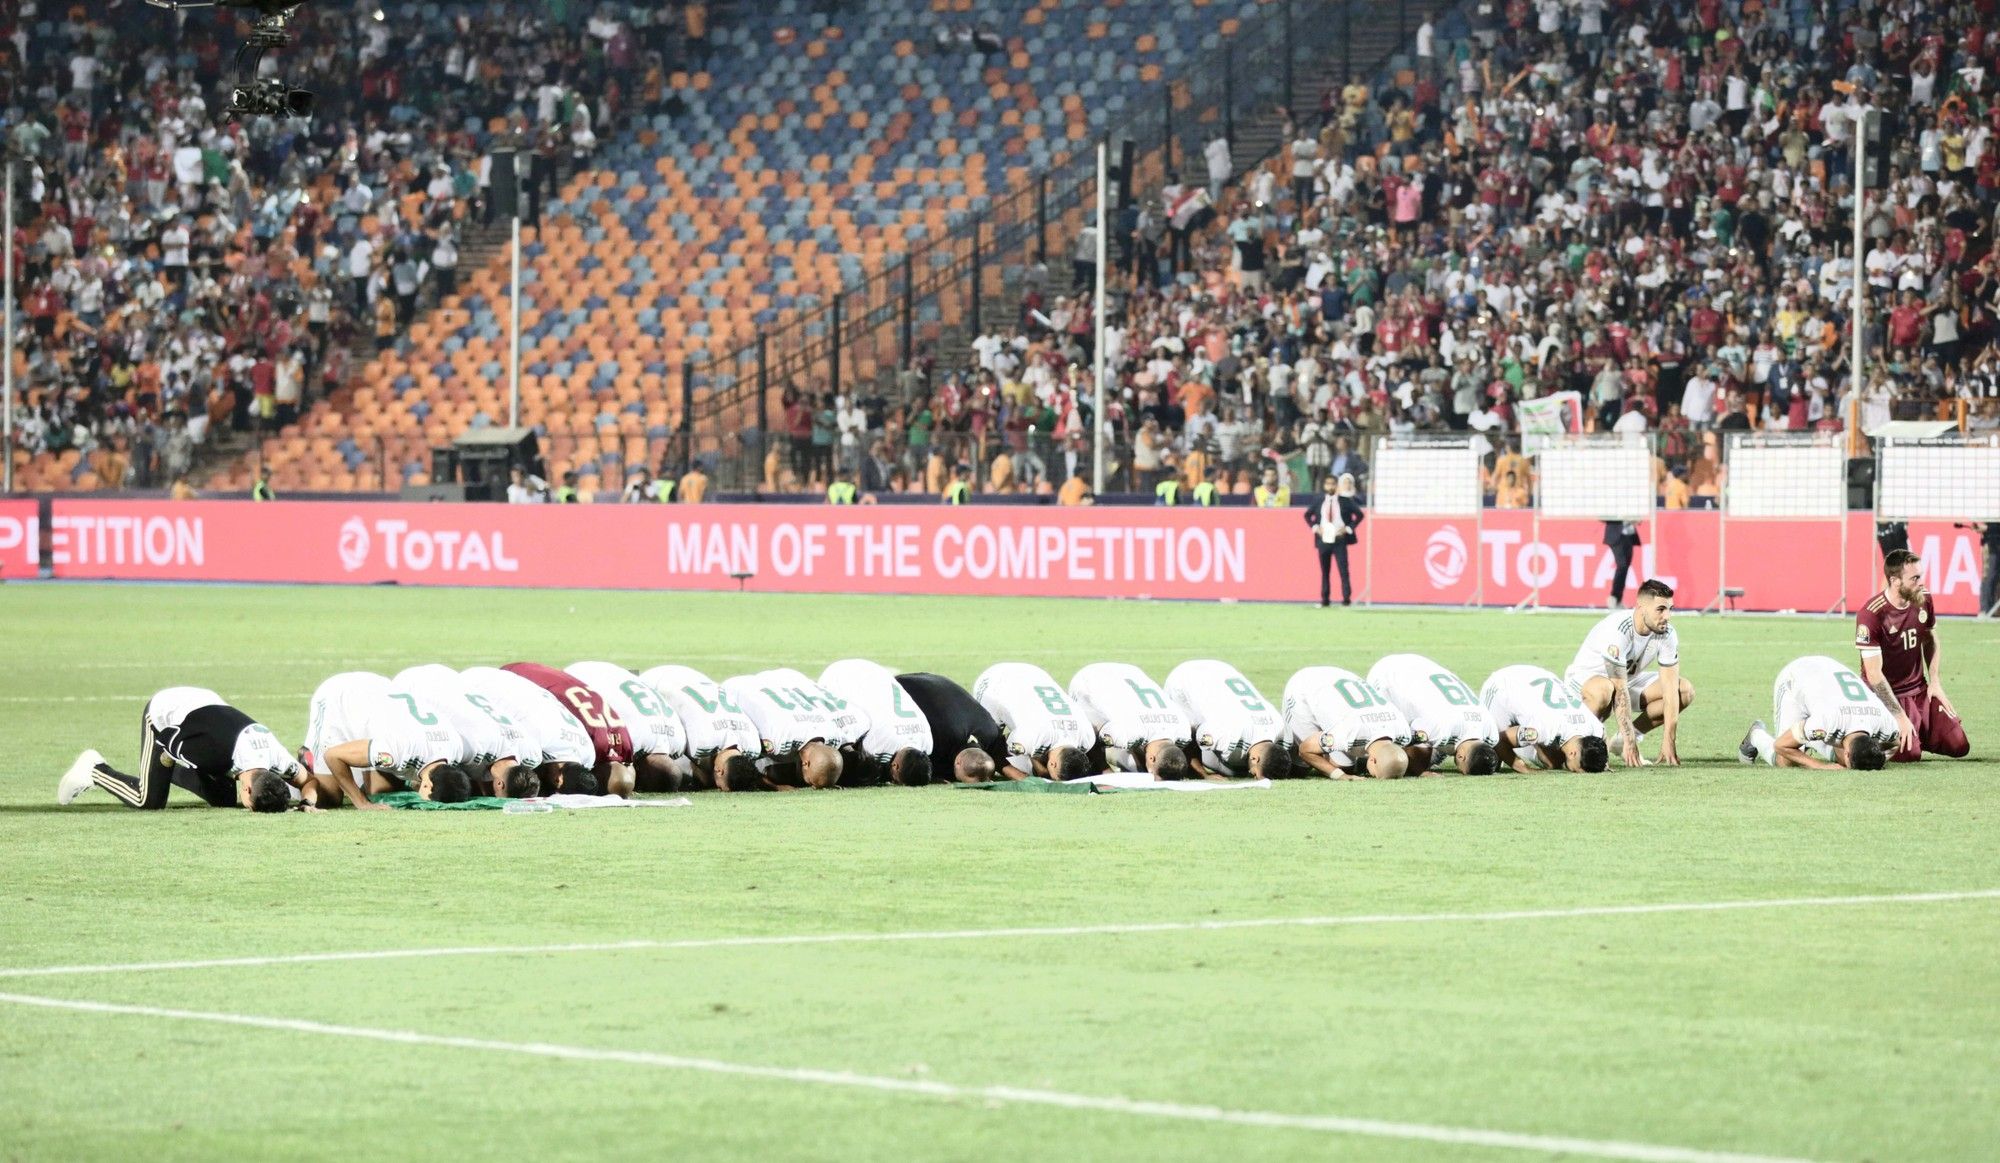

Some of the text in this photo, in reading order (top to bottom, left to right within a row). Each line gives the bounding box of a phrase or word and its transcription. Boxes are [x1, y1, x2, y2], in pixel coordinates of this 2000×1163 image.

[376, 518, 518, 572] TOTAL
[668, 522, 1246, 583] MAN OF THE COMPETITION
[1900, 628, 1917, 650] 16
[891, 682, 917, 719] 7
[1033, 685, 1072, 716] 8
[1124, 678, 1167, 709] 4
[1225, 678, 1266, 712] 6
[1333, 678, 1387, 710] 10
[1429, 673, 1480, 706] 19
[1834, 671, 1868, 701] 9
[388, 692, 439, 726] 2
